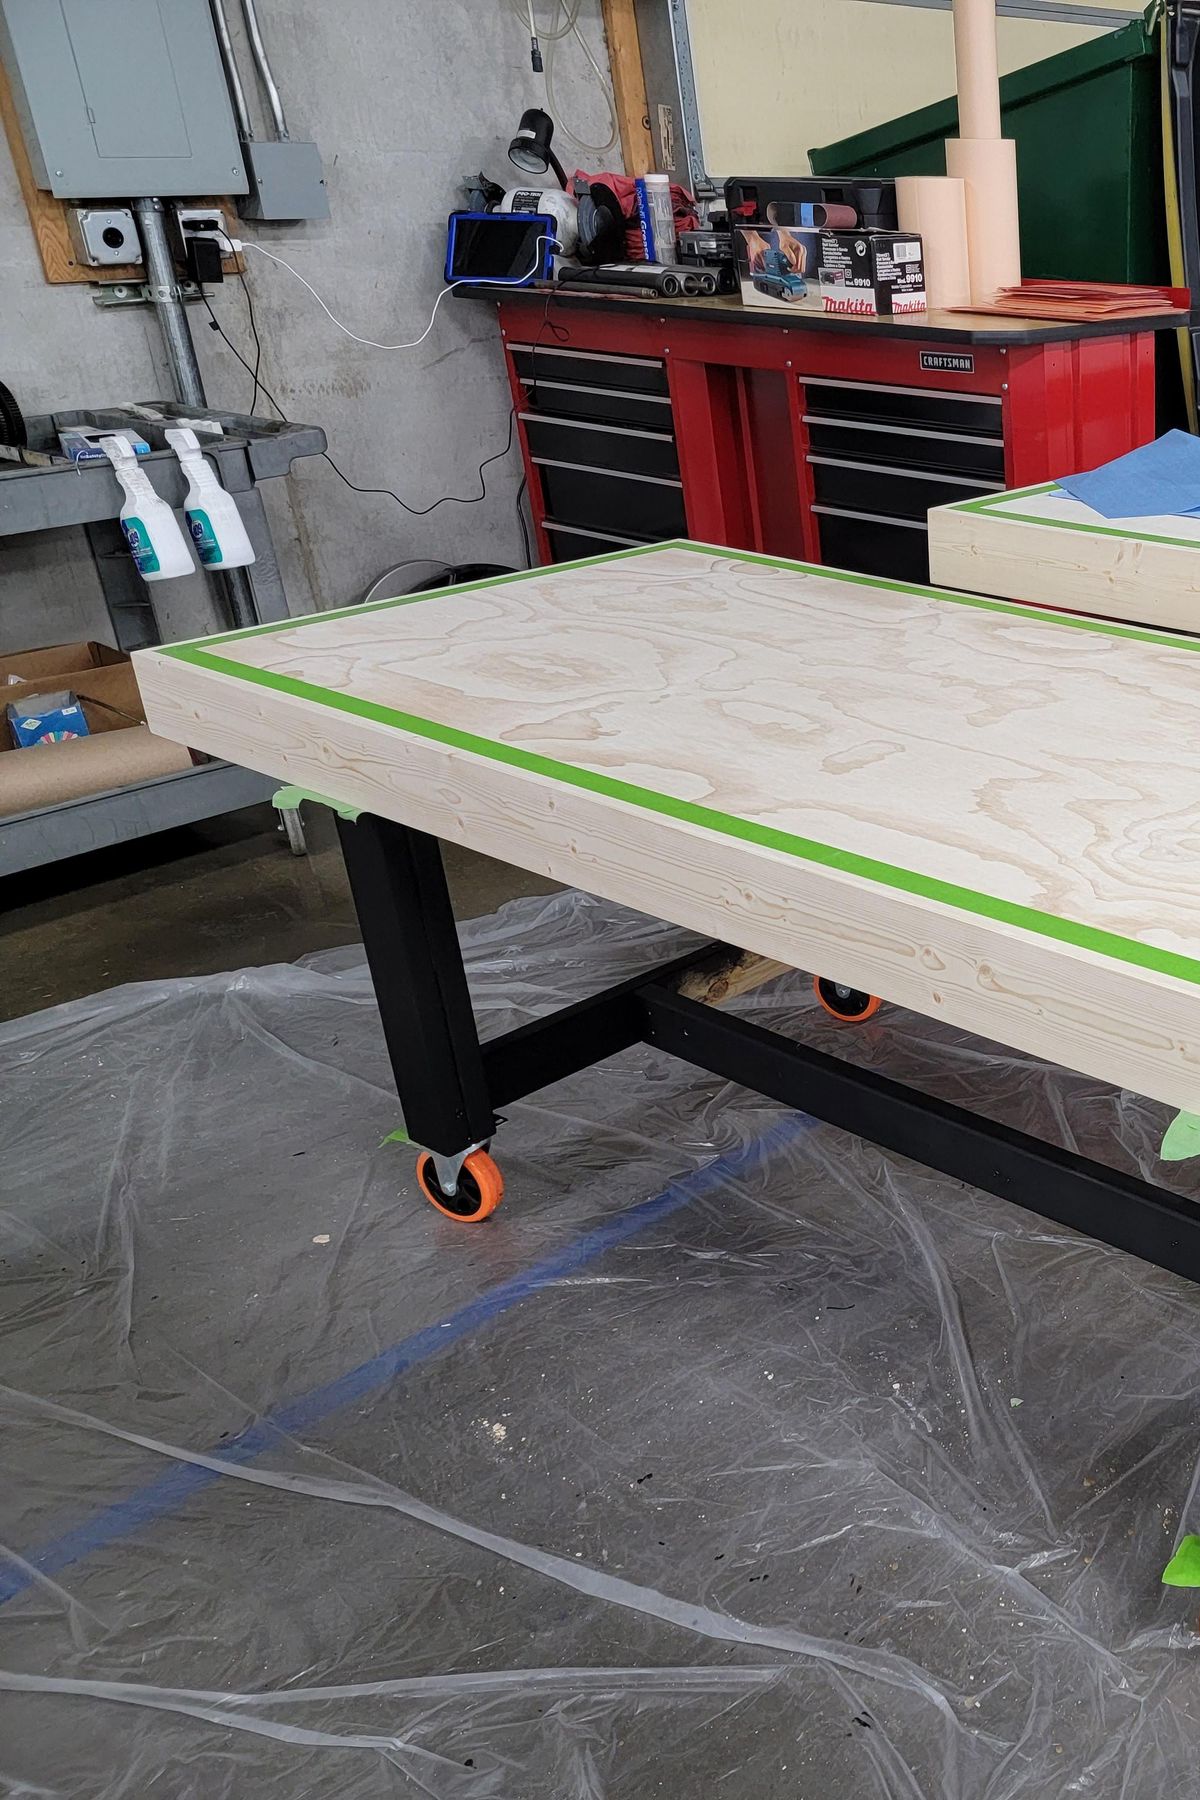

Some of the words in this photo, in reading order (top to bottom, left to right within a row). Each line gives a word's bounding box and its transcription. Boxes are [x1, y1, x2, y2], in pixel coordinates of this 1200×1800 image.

[853, 278, 871, 287] 9910
[905, 273, 923, 283] 9910
[822, 296, 878, 316] makita
[923, 355, 971, 369] CRAFTSMAN
